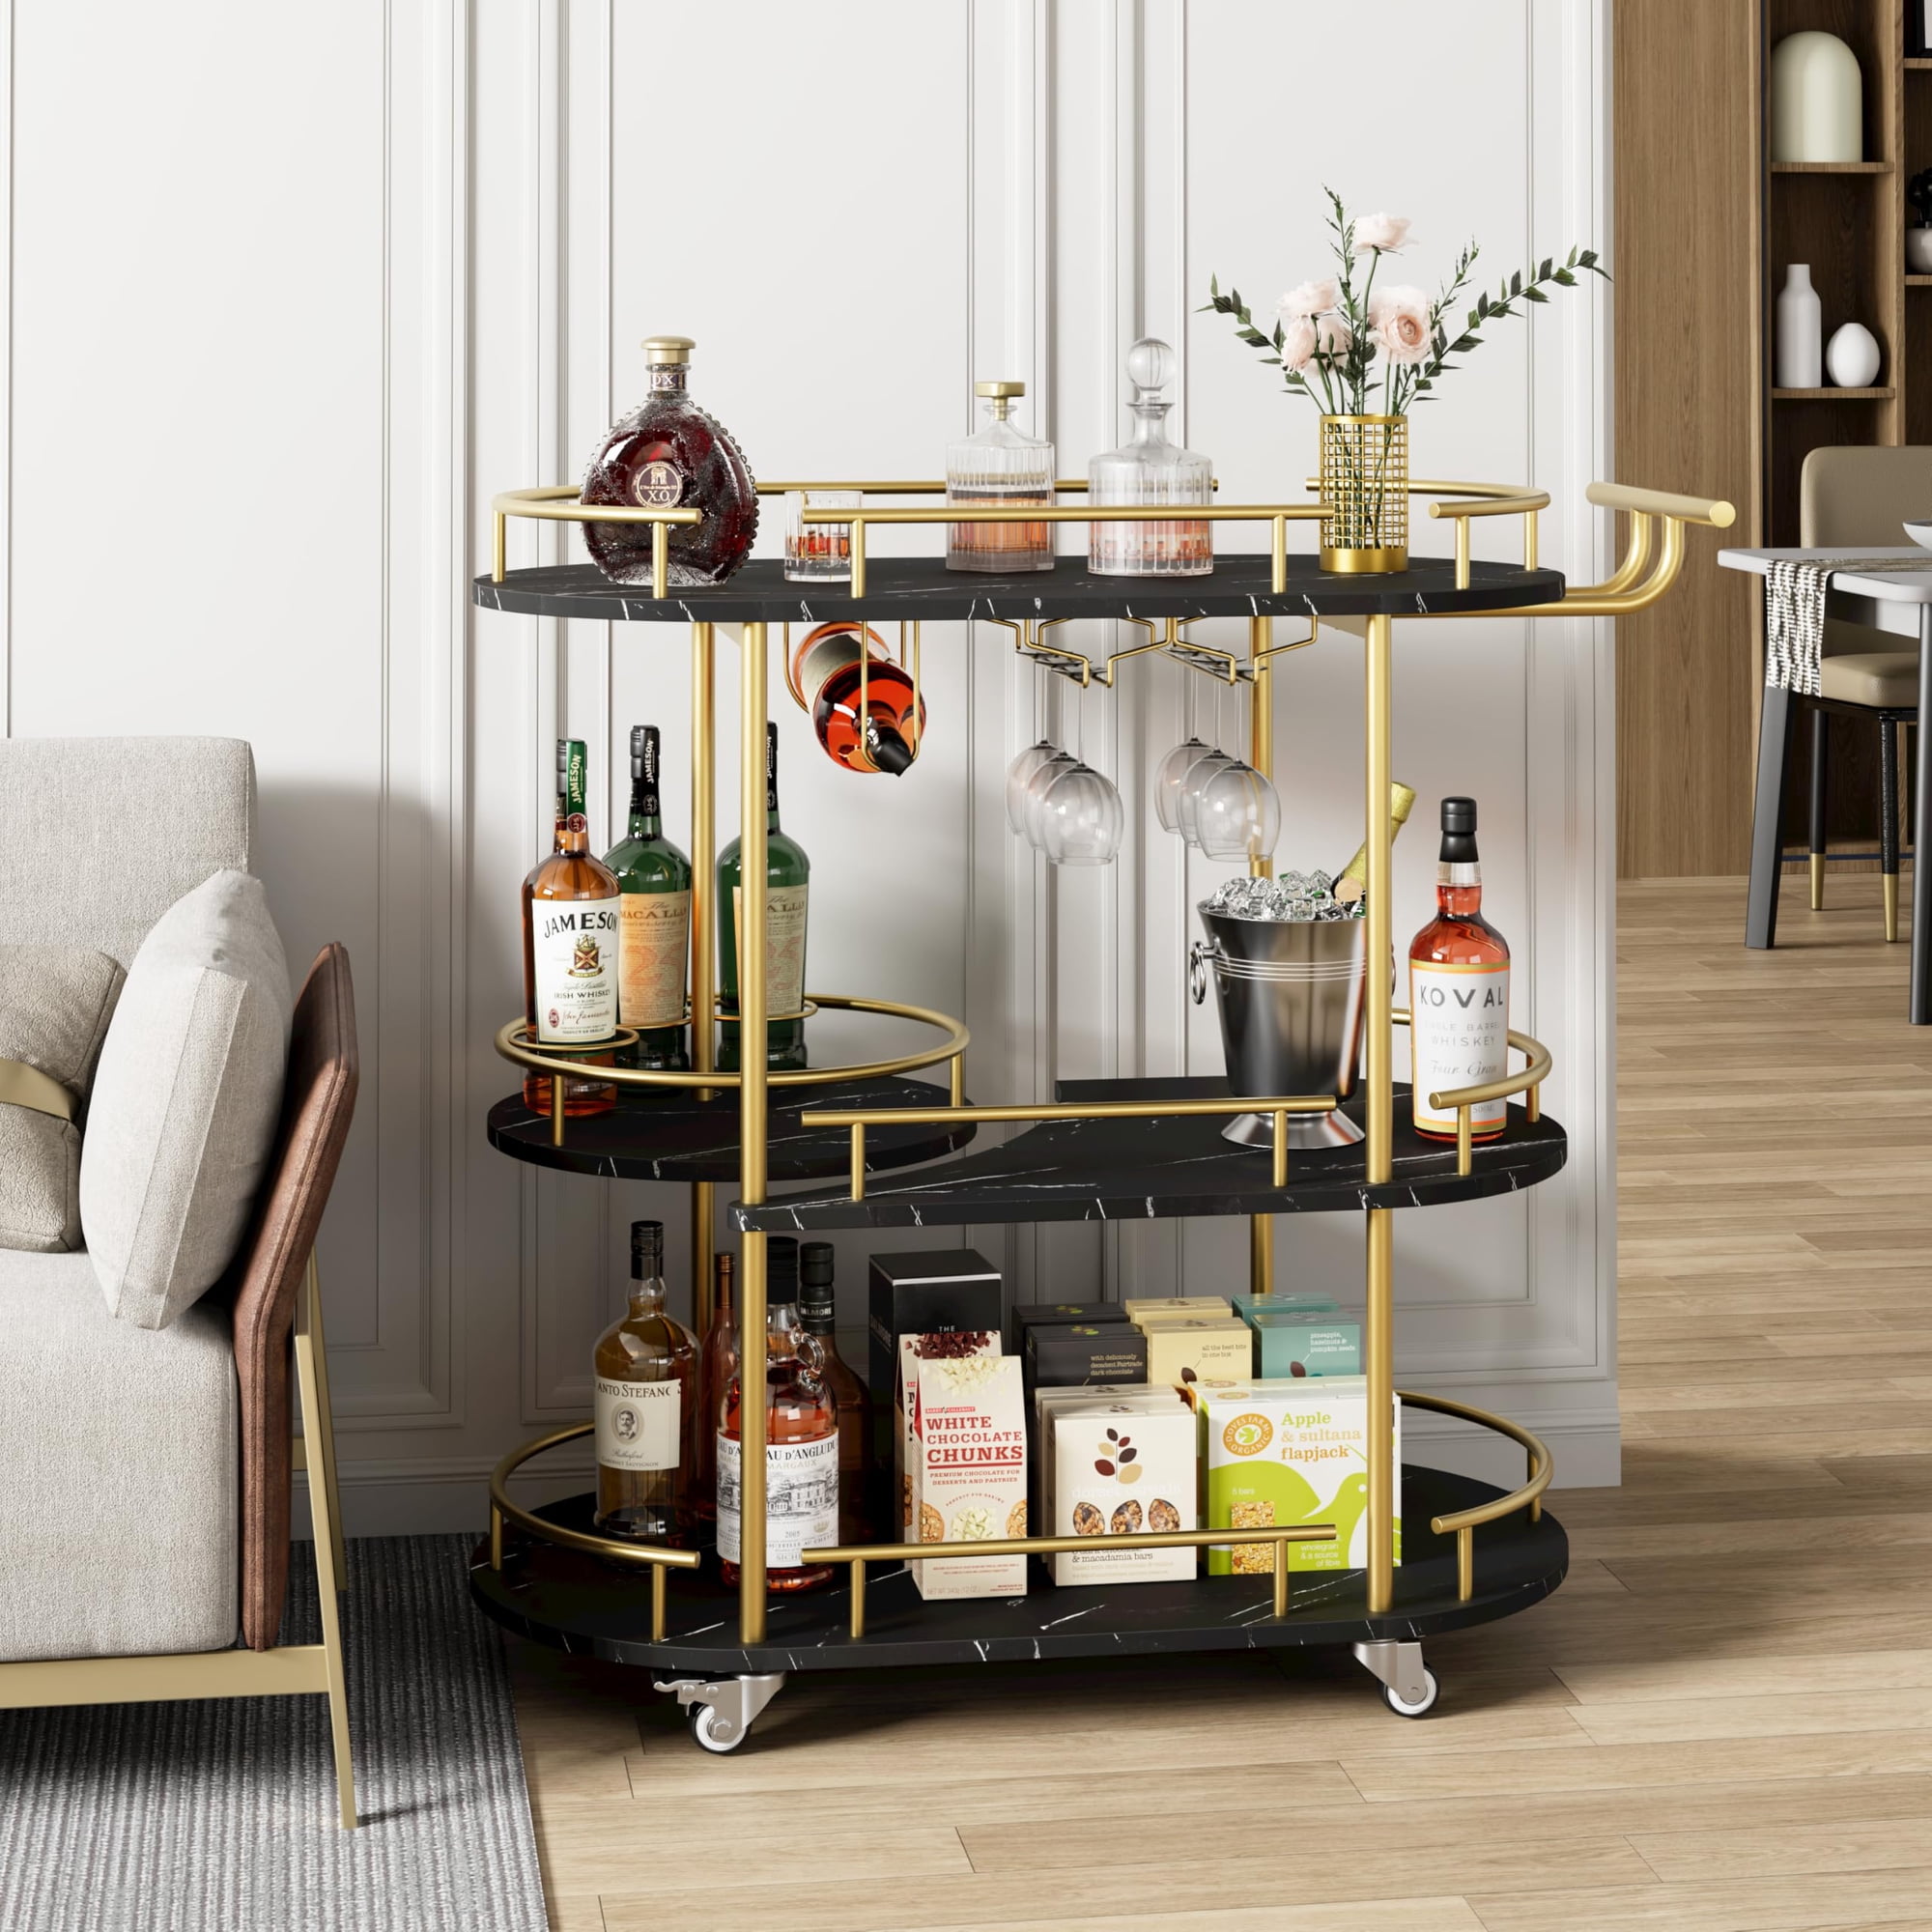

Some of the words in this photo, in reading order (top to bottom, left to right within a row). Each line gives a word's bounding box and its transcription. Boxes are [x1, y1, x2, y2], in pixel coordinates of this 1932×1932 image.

[644, 739, 655, 783] JAMESON
[569, 754, 582, 803] JAMESON
[544, 911, 618, 938] JAMESON
[1420, 985, 1503, 1009] KOVAL
[598, 1382, 620, 1397] ANTO
[925, 1416, 992, 1431] WHITE
[1281, 1412, 1331, 1428] Apple
[927, 1431, 1023, 1445] CHOCOLATE
[1281, 1430, 1294, 1443] &
[1299, 1428, 1361, 1442] sultana
[1231, 1434, 1270, 1455] ORGANIC
[927, 1446, 1023, 1463] CHUNKS
[1281, 1445, 1350, 1463] flapjack
[1082, 1552, 1132, 1563] macadamia
[1134, 1551, 1153, 1561] bars
